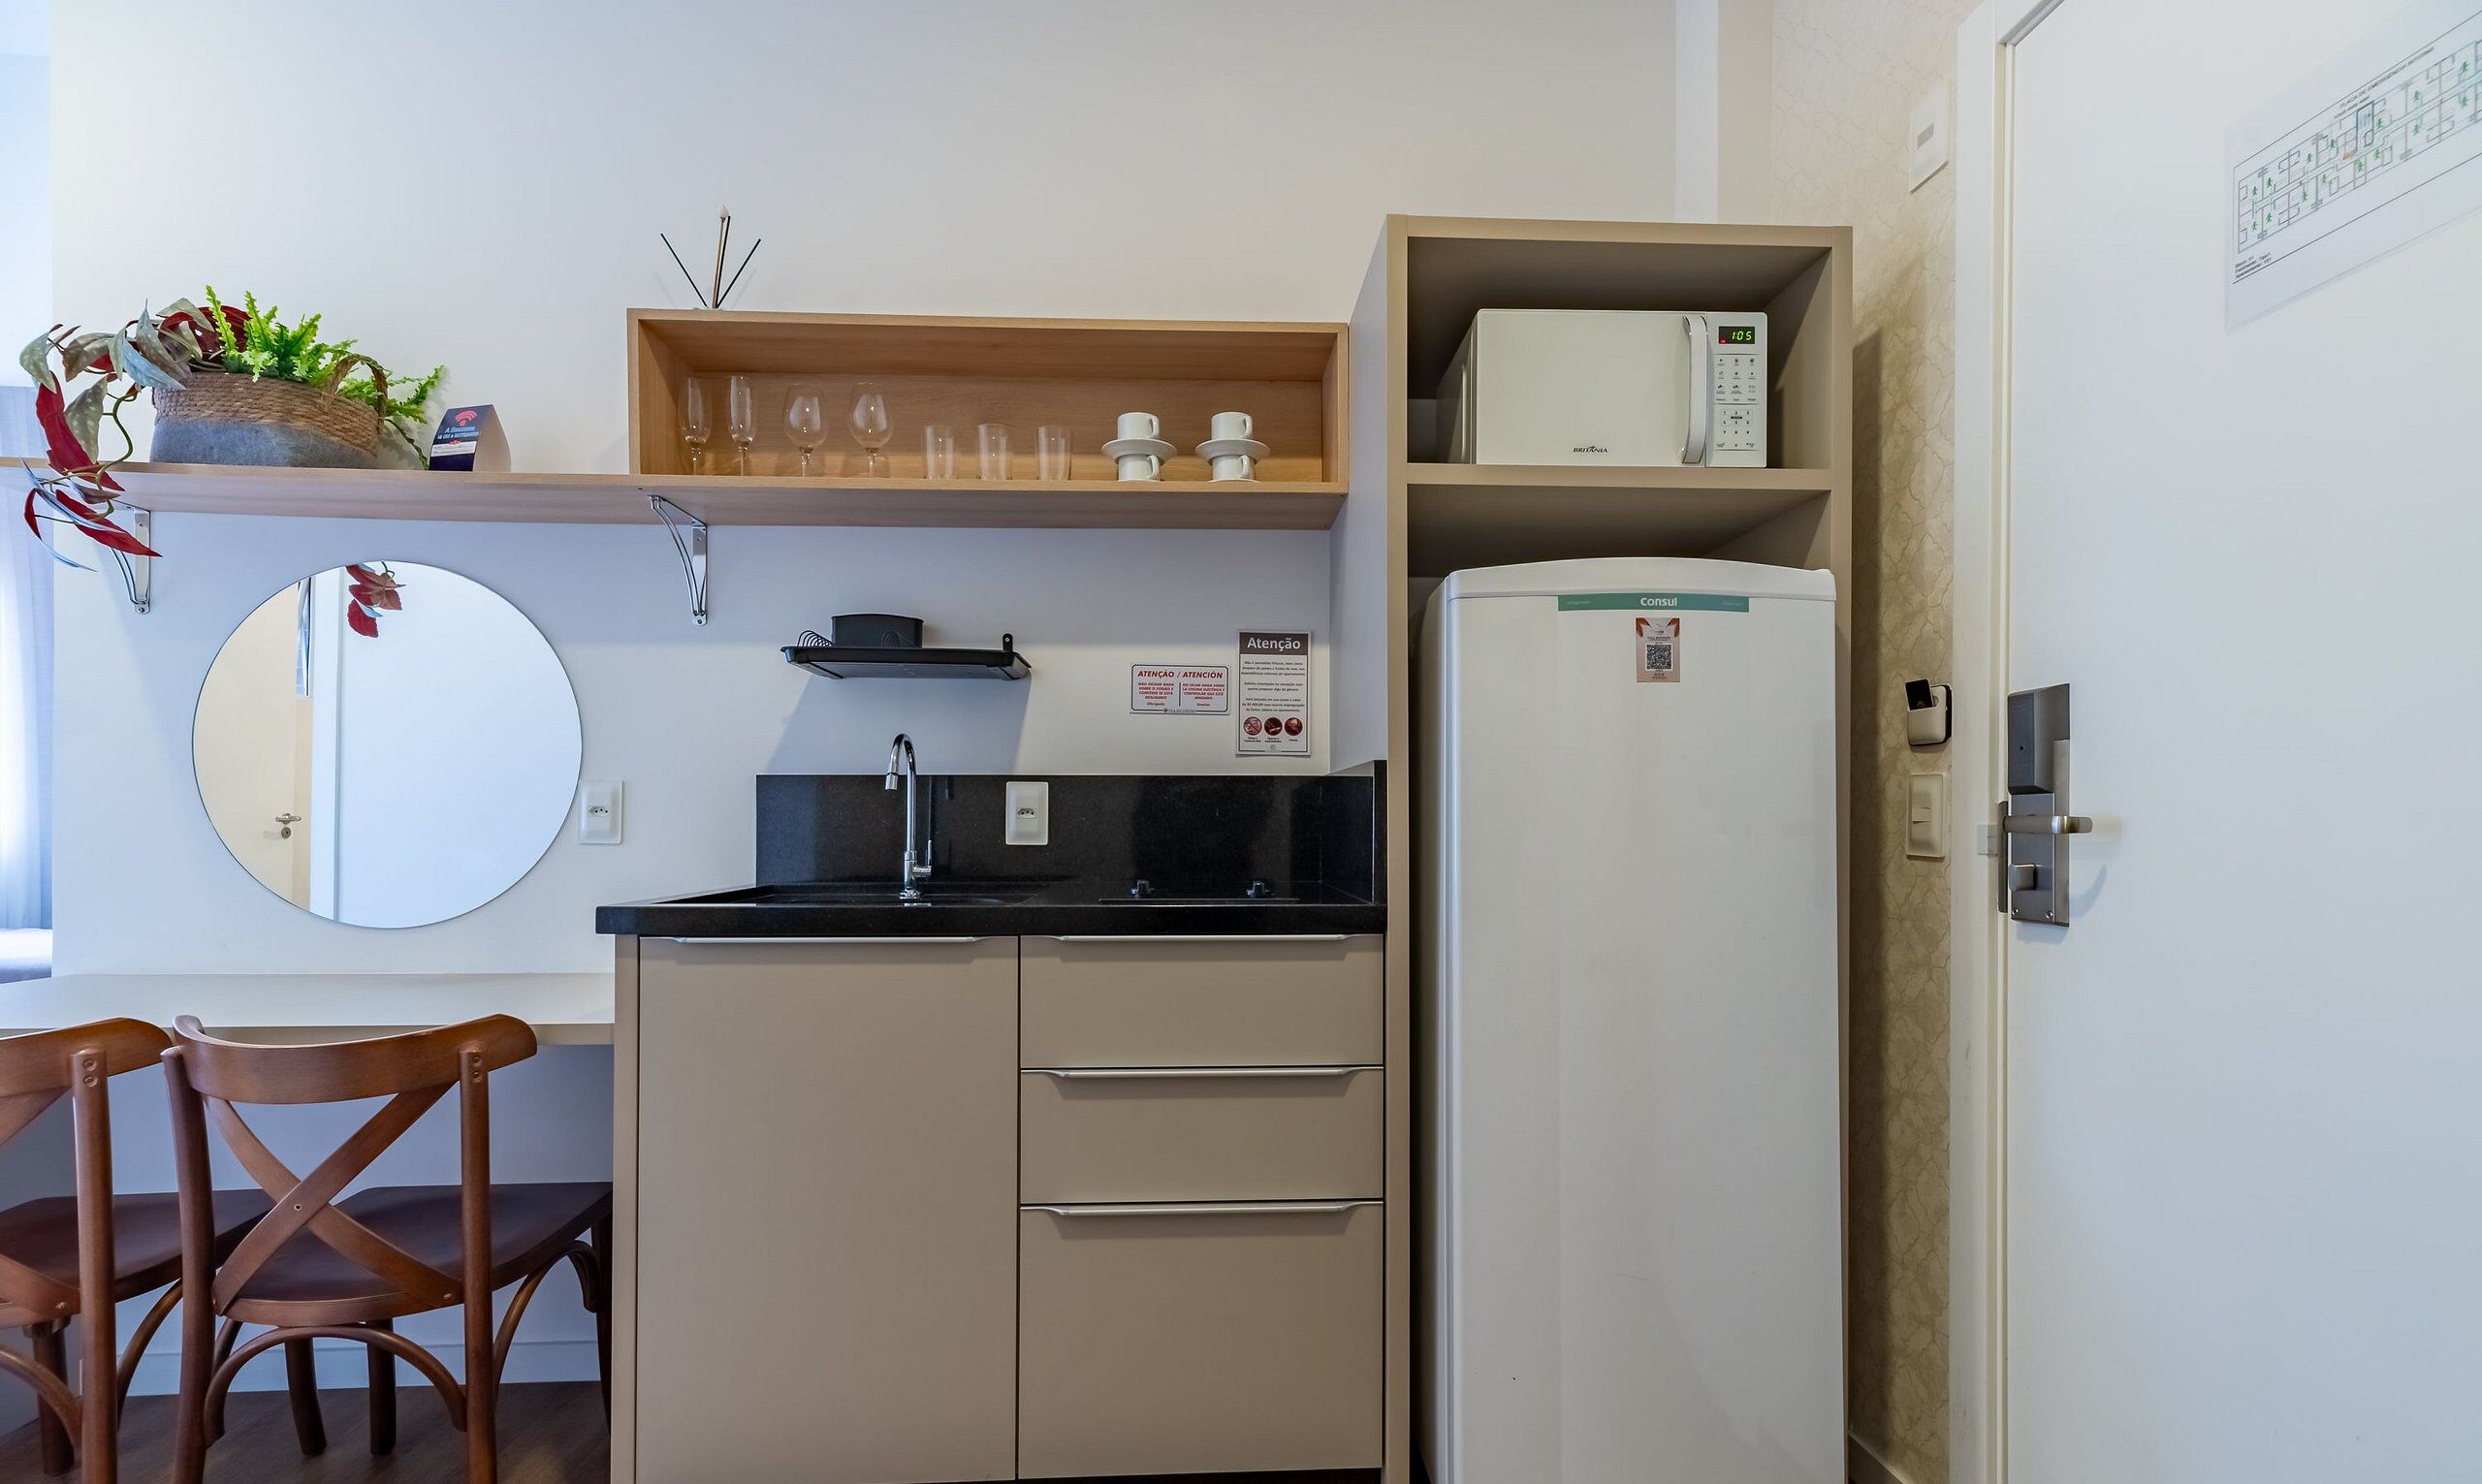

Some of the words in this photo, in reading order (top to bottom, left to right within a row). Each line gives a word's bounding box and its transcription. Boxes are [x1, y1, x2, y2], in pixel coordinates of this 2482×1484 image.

[1247, 637, 1301, 651] Atenção
[1137, 670, 1175, 679] ATENÇÃO
[1182, 670, 1224, 679] ATENCIÓN
